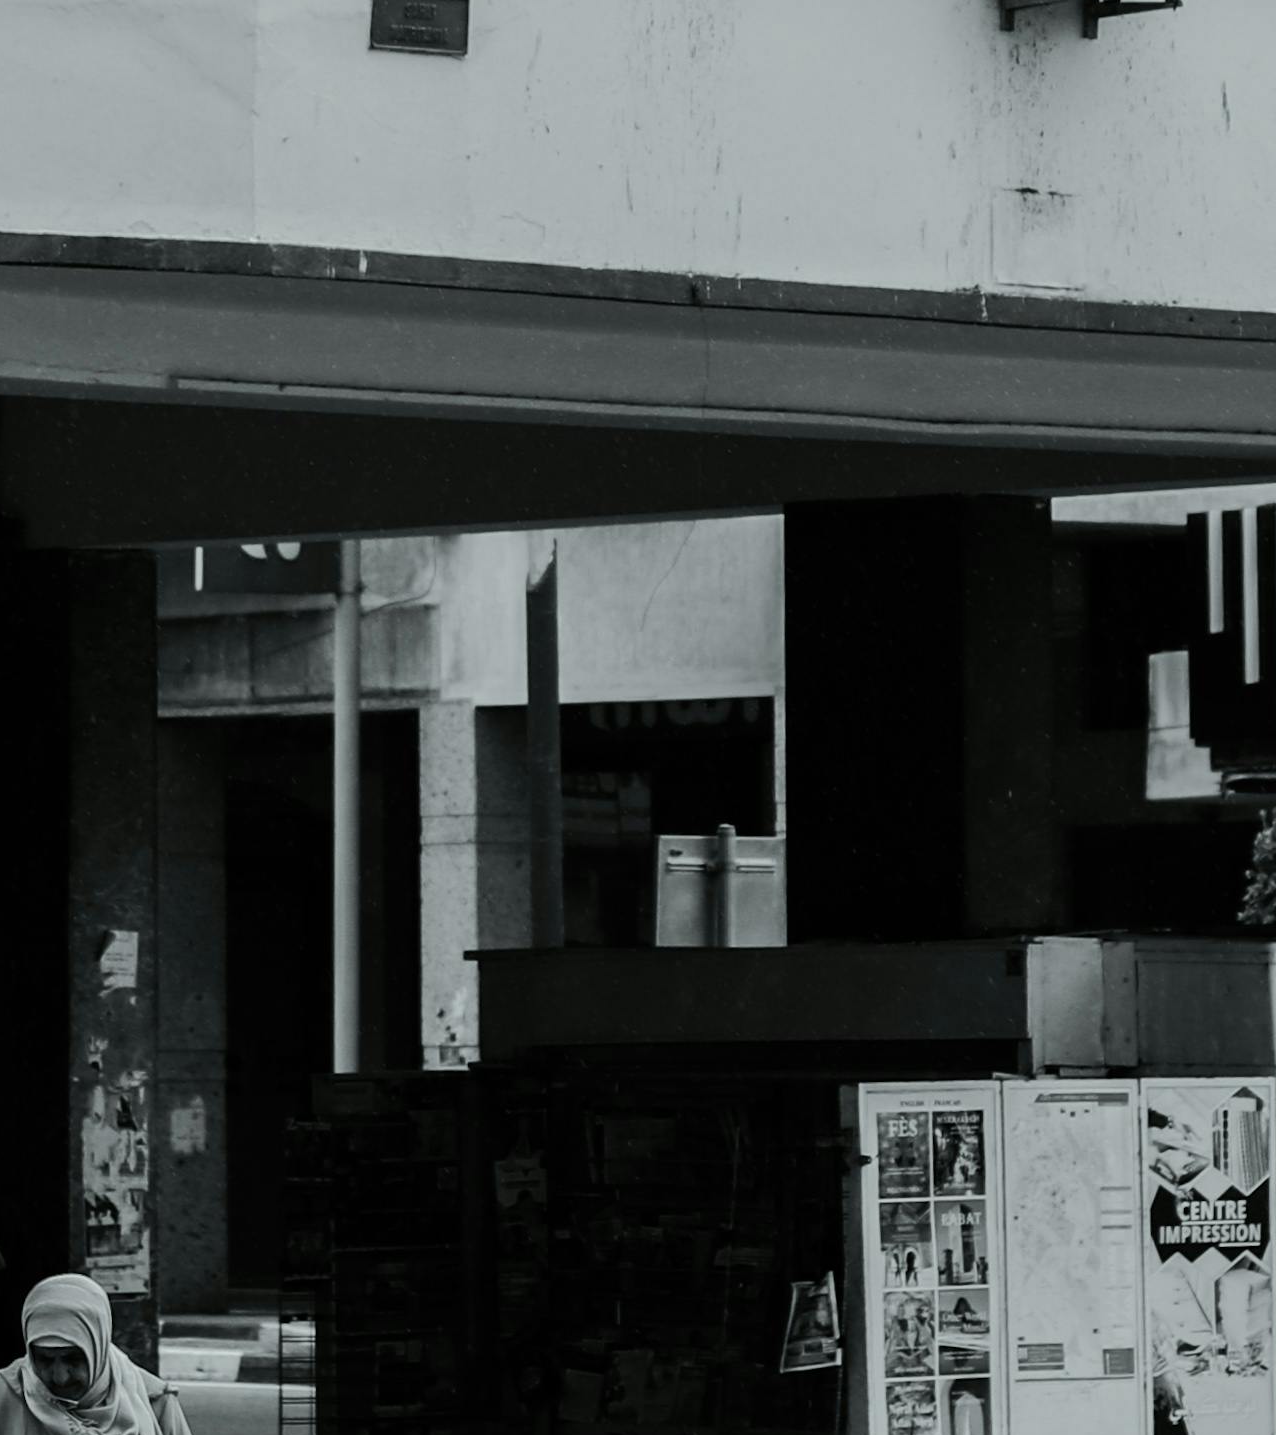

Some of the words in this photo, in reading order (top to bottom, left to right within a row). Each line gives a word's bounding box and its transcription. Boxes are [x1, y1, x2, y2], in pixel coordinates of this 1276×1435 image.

[887, 1116, 919, 1138] FÈS
[940, 1211, 983, 1227] RABAT
[1177, 1200, 1247, 1221] CENTRE
[1159, 1224, 1262, 1245] IMPRESSION
